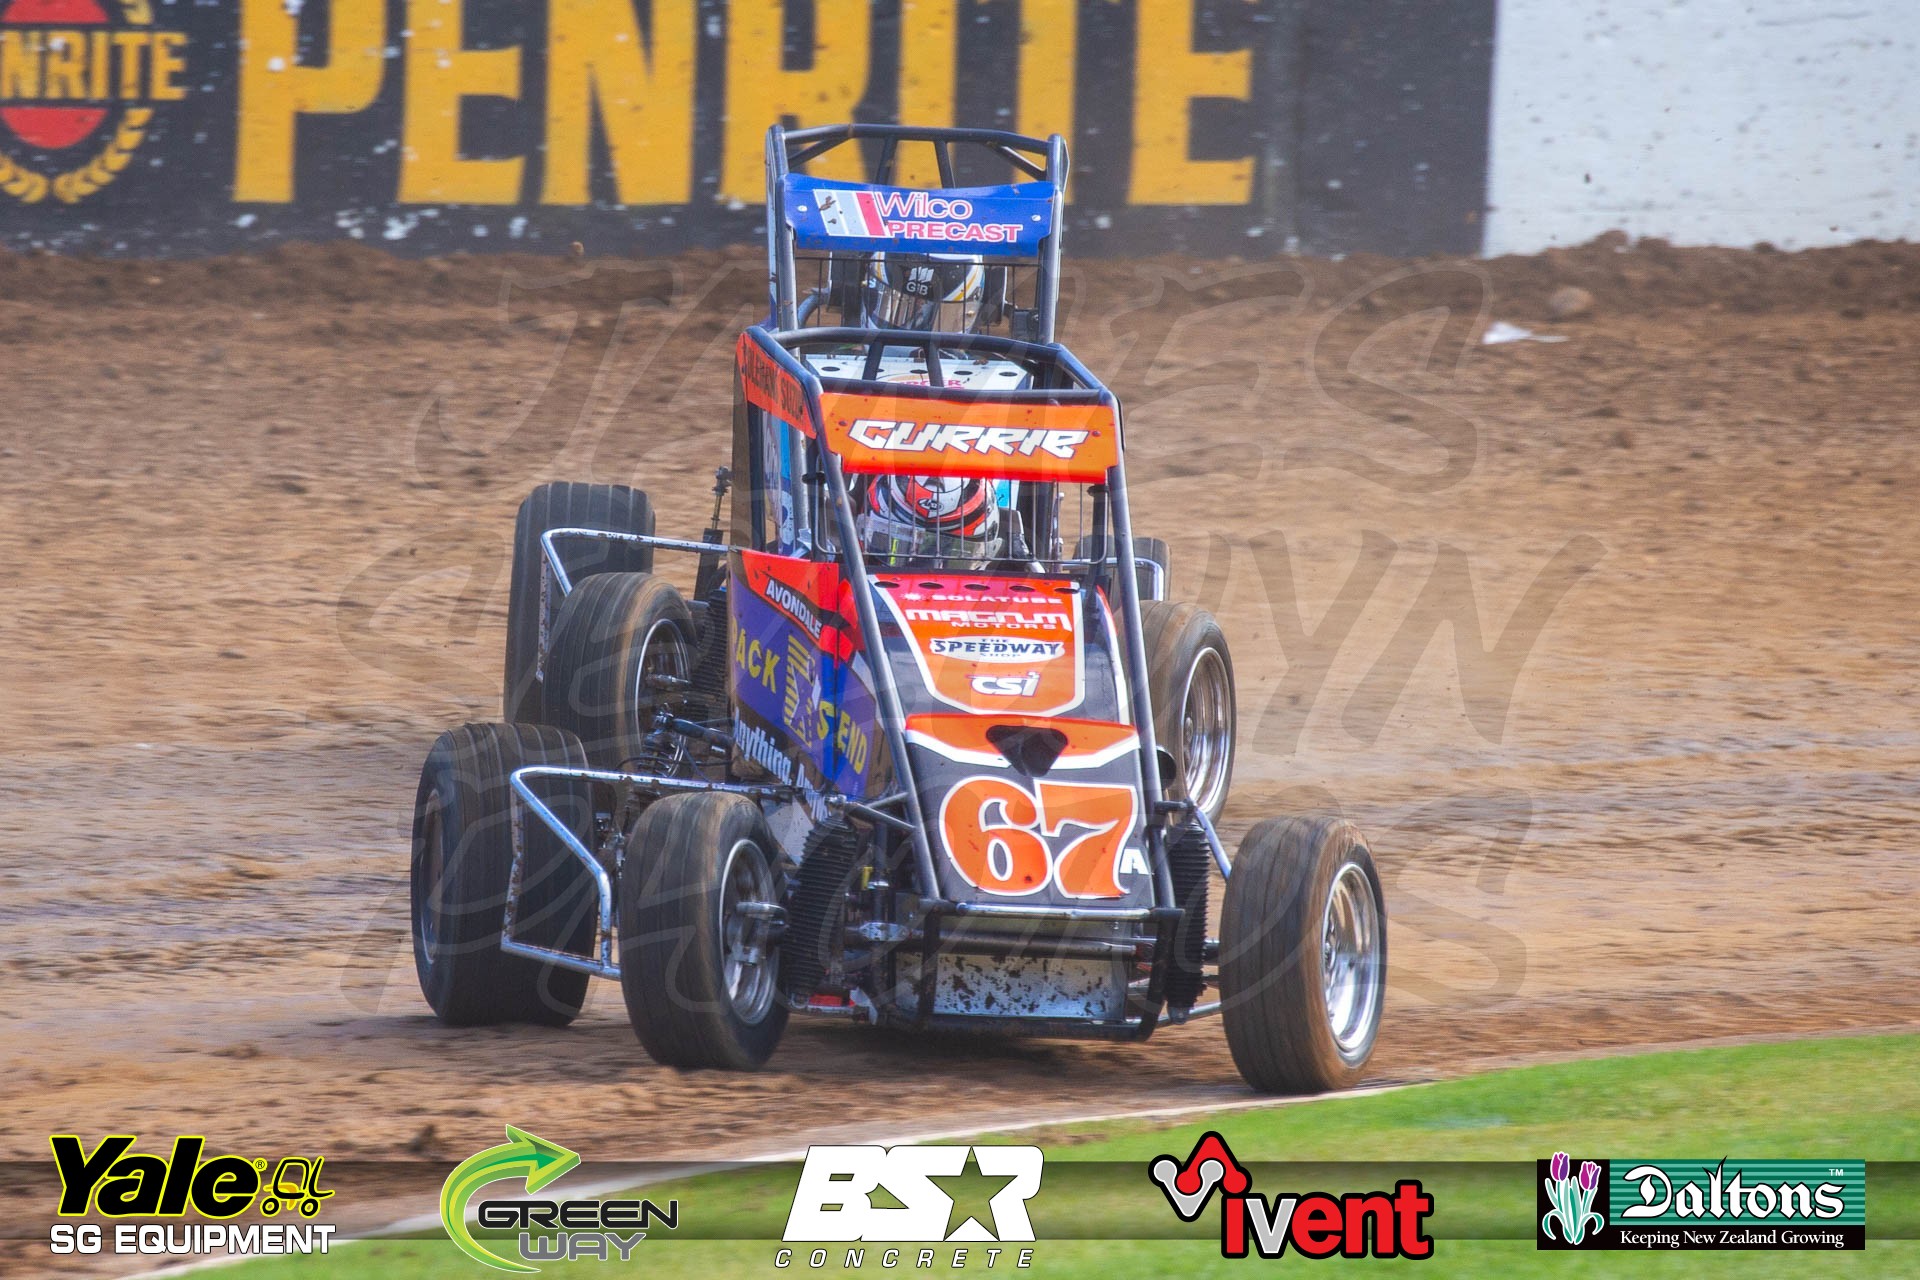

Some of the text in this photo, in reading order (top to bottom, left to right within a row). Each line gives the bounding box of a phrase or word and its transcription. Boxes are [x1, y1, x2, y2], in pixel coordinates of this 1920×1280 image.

[230, 0, 1258, 205] PENRITE
[876, 191, 973, 221] Wilco
[887, 220, 1023, 242] PRECAST
[848, 419, 1090, 459] CURRIE
[765, 579, 823, 640] AVONDALE
[951, 620, 1057, 630] MOTORS
[933, 639, 1062, 656] SPEEDWAY
[939, 775, 1139, 899] 67
